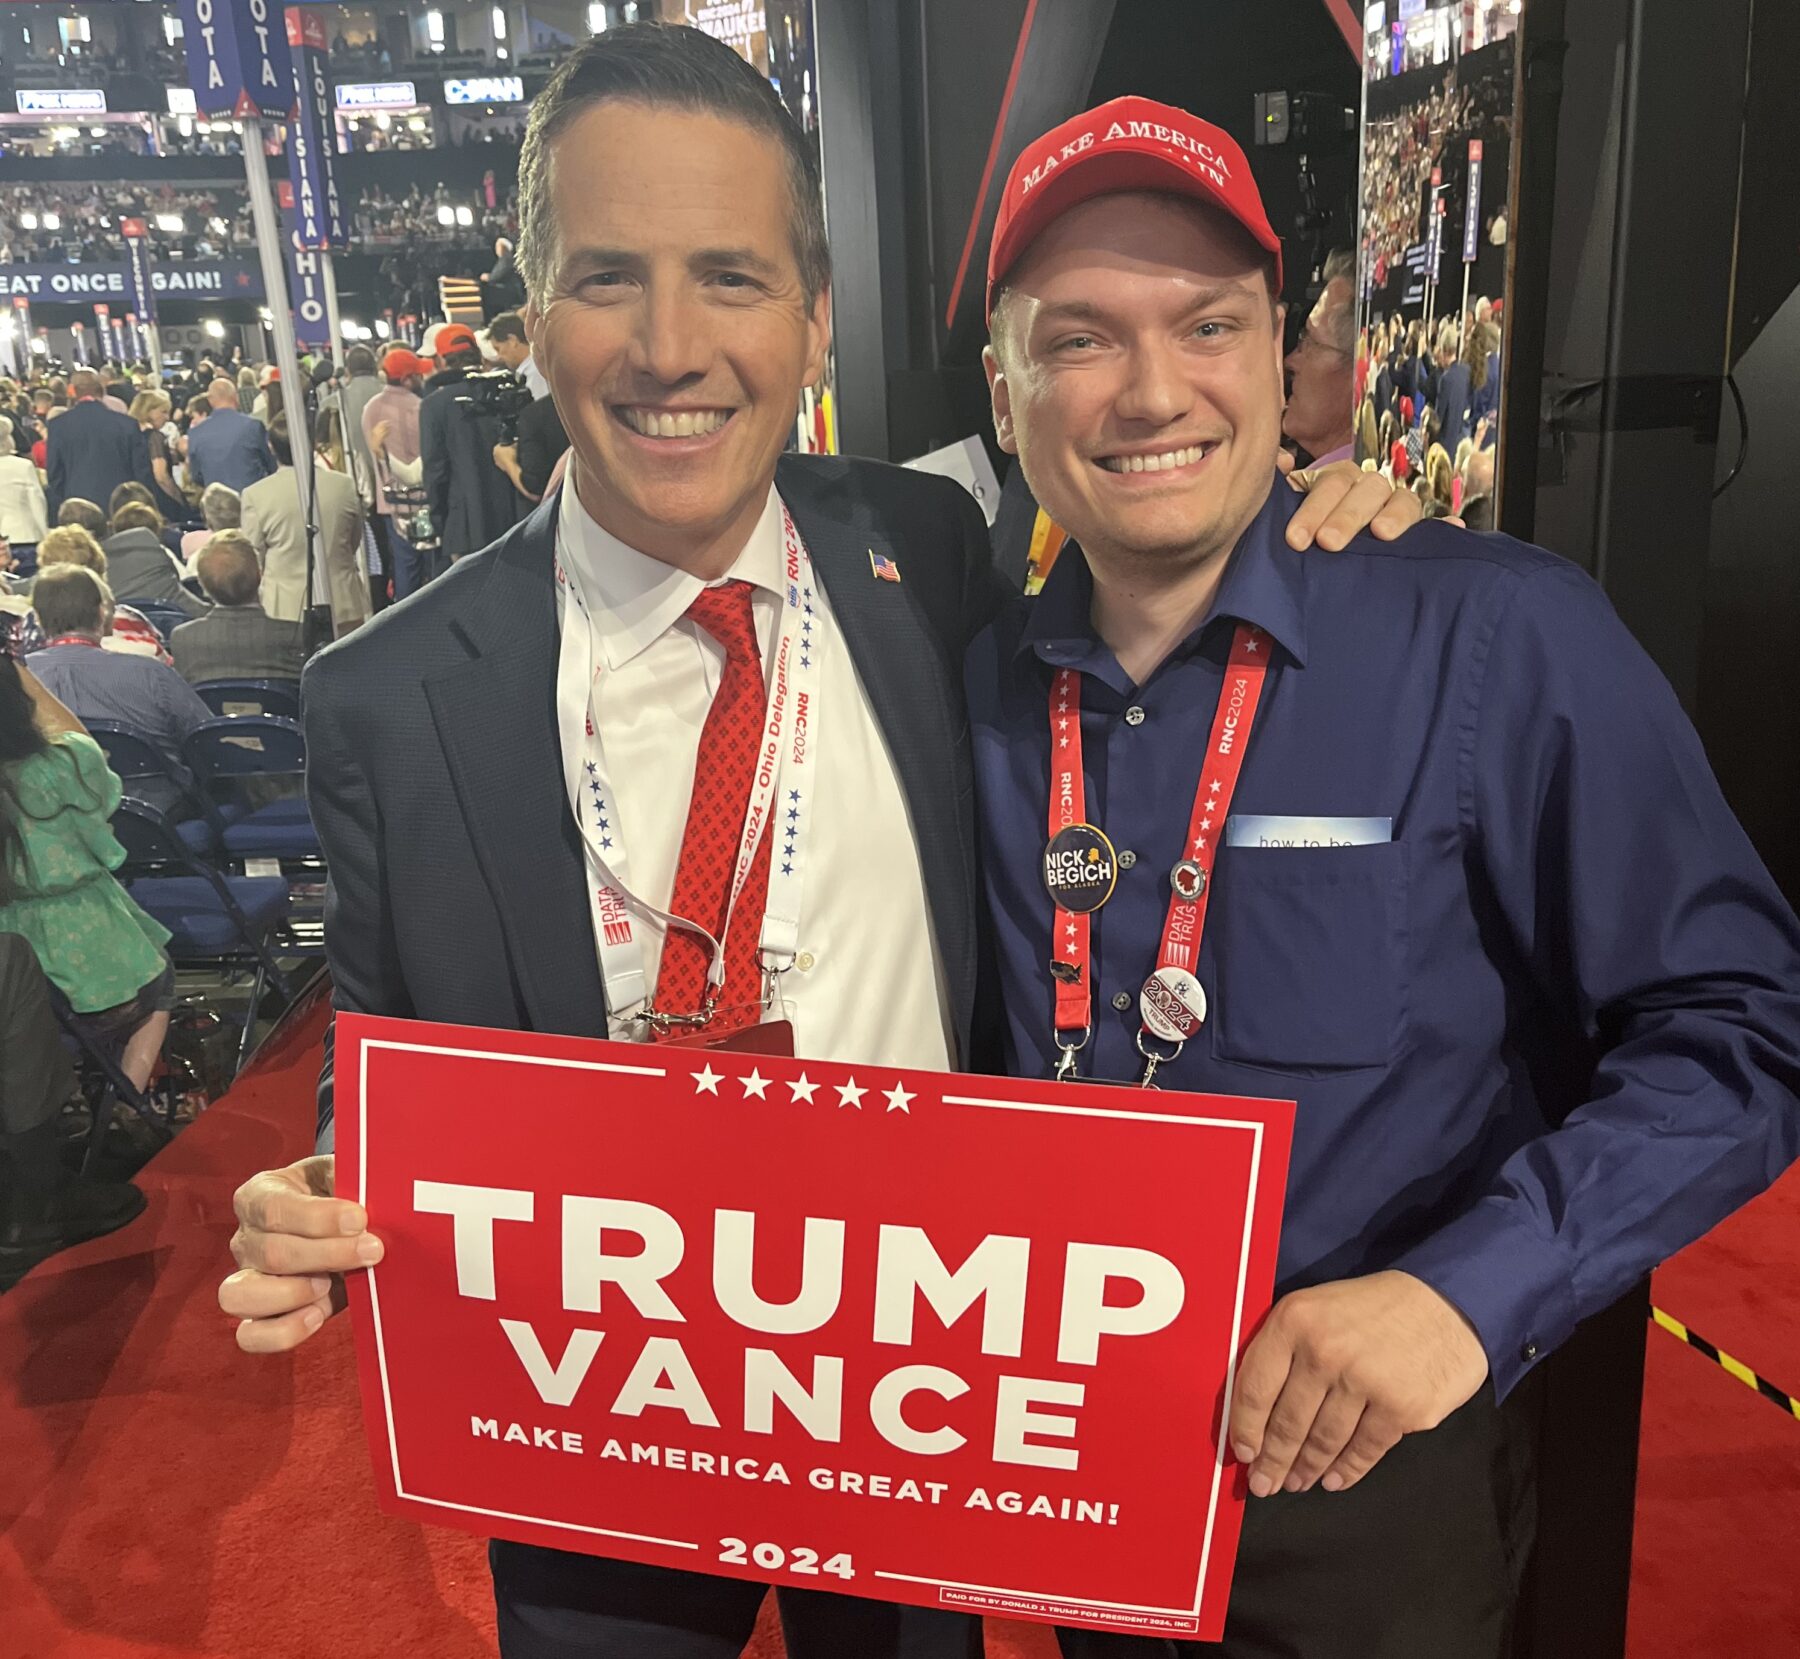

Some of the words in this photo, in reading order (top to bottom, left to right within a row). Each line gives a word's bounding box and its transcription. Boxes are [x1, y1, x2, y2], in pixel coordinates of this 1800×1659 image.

[313, 56, 342, 237] LOUISIANA
[1022, 132, 1094, 194] MAKE
[1102, 121, 1232, 178] AMERICA
[51, 273, 124, 293] ONCE
[151, 271, 222, 290] GAIN!
[786, 541, 799, 582] RNC
[793, 692, 809, 765] RNC2024
[1218, 679, 1248, 755] RNC2024
[744, 805, 763, 851] 2024
[759, 742, 777, 788] Ohio
[769, 636, 790, 737] Delegation
[1060, 772, 1073, 829] RNC20
[1045, 849, 1086, 870] NICK
[1259, 835, 1294, 848] how
[1303, 838, 1320, 848] to
[1047, 862, 1111, 886] BEGICH
[598, 886, 615, 923] DATA
[1168, 905, 1186, 941] DATA
[1180, 902, 1198, 942] TRUS
[1144, 980, 1194, 1031] 2024
[1148, 1008, 1170, 1031] TRUMP
[413, 1180, 1186, 1366] TRUMP
[499, 1319, 1086, 1471] VANCE
[472, 1416, 583, 1454] MAKE
[600, 1438, 790, 1485] AMERICA
[808, 1468, 949, 1504] GREAT
[965, 1487, 1120, 1526] AGAIN!
[718, 1538, 856, 1580] 2024
[946, 1592, 967, 1600] PAID
[968, 1595, 987, 1603] FOR
[1001, 1600, 1039, 1610] DONALD
[1048, 1606, 1079, 1615] TRUMP
[1080, 1610, 1099, 1618] FOR
[1099, 1613, 1149, 1624] PRESIDENT
[1149, 1618, 1173, 1627] 2024,
